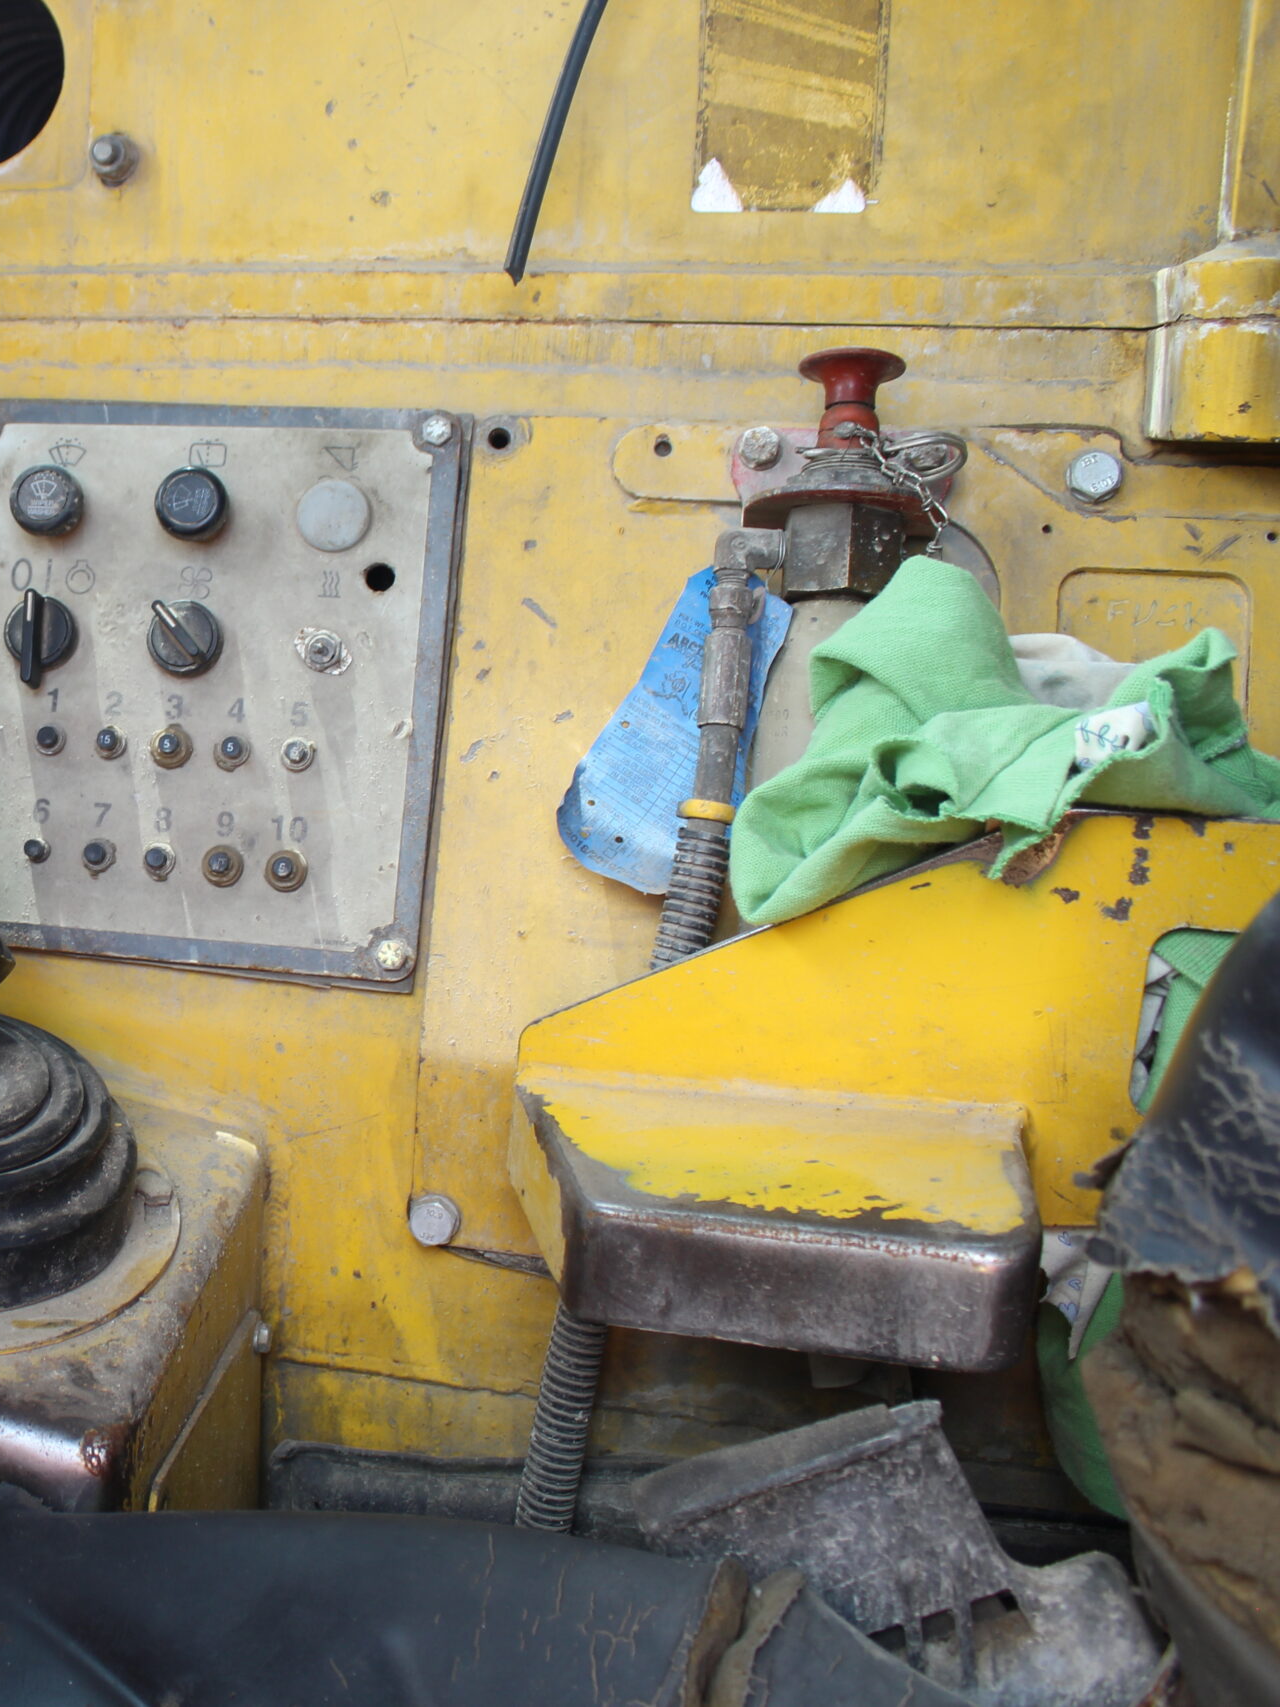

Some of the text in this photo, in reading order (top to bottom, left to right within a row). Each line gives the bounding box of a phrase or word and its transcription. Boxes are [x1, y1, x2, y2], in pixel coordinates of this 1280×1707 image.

[48, 688, 310, 727] 1 2 3 4 5
[33, 798, 51, 825] 6
[94, 803, 112, 828] 7
[217, 811, 234, 837] 9
[271, 816, 308, 843] 10
